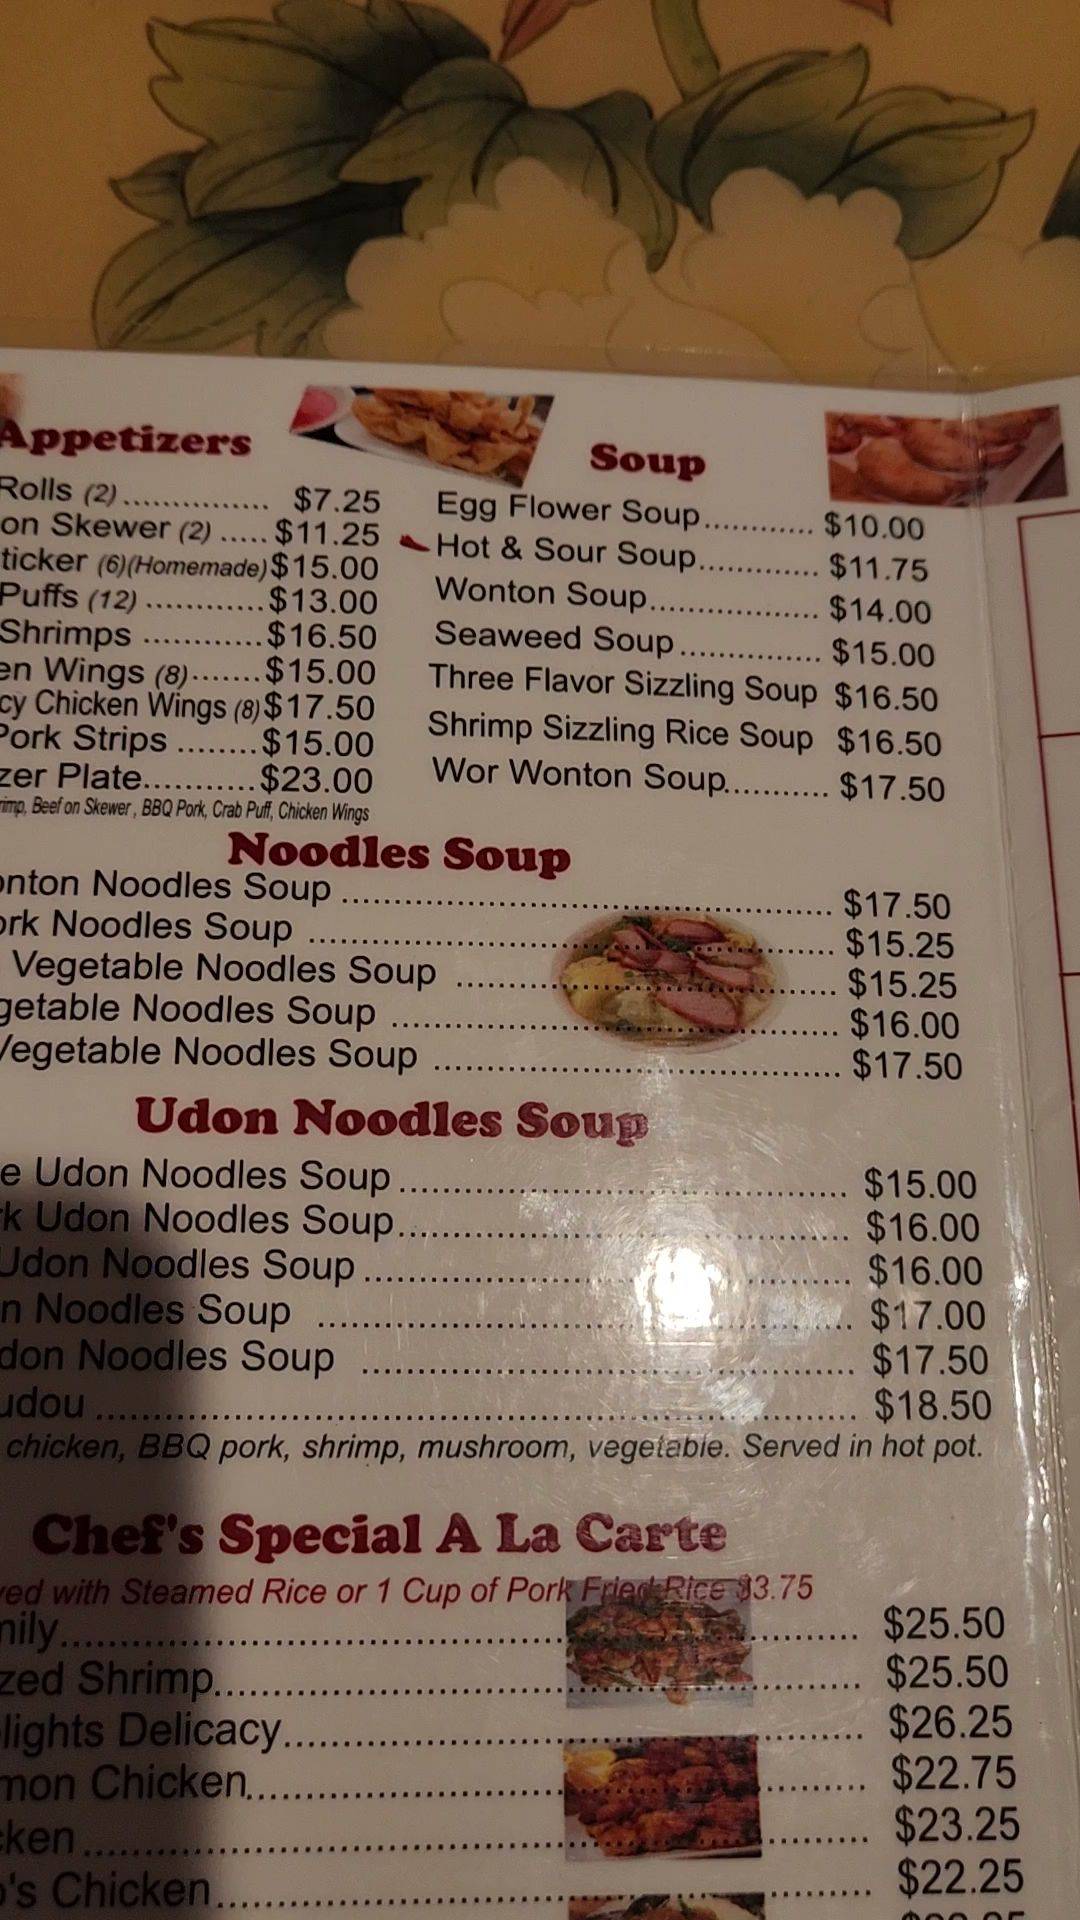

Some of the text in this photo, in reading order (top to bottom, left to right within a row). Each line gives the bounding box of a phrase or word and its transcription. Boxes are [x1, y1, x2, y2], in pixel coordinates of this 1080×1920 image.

[590, 443, 706, 482] Soup
[84, 483, 116, 507] (2)
[294, 485, 380, 514] $7.25
[438, 491, 925, 541] Egg Flower Soup $10.00
[0, 512, 379, 547] on Skewer (2) $11.25
[1, 546, 88, 572] ticker
[270, 551, 378, 581] $15.00
[438, 533, 928, 582] Hot & Sour Soup $11.75
[88, 589, 136, 614] (12)
[269, 585, 377, 615] $13.00
[435, 576, 931, 624] Wonton Soup $14.00
[267, 620, 376, 650] $16.50
[435, 620, 935, 668] Seaweed Soup $15.00
[44, 656, 144, 694] Wings
[155, 664, 187, 690] (8)
[266, 655, 375, 686] $15.00
[428, 663, 938, 712] Three Flavor Sizzling Soup $16.50
[35, 689, 374, 725] Chicken Wings (8) $17.50
[73, 724, 373, 758] Strips $15.00
[428, 710, 942, 757] Shrimp Sizzling Rice Soup $16.50
[58, 762, 142, 790] Plate
[260, 763, 372, 795] $23.00
[432, 756, 945, 802] Wor Wonton Soup $17.50
[31, 796, 369, 826] Beef on Skewer BBQ Pork, Crab Puff, Chicken Wings
[228, 831, 571, 880] Noodles Soup
[93, 869, 950, 920] Noodles Soup $17.50
[53, 909, 954, 959] Noodles Soup $15.25
[12, 949, 957, 1000] Vegetable Noodles Soup $15.25
[133, 993, 274, 1024] Noodles
[287, 995, 375, 1032] Soup
[851, 1007, 959, 1040] $16.00
[175, 1036, 316, 1067] Noodles
[329, 1039, 417, 1076] Soup
[853, 1048, 962, 1081] $17.50
[135, 1096, 649, 1148] Udon Noodles Soup
[36, 1157, 976, 1202] Udon Noodles Soup $15.00
[36, 1200, 979, 1245] Udon Noodles Soup $16.00
[102, 1247, 249, 1282] Noodles
[263, 1249, 354, 1288] Soup
[869, 1253, 982, 1289] $16.00
[35, 1292, 985, 1334] Noodles Soup $17.00
[78, 1338, 227, 1373] Noodles
[241, 1340, 334, 1380] Soup
[873, 1342, 988, 1379] $17.50
[875, 1387, 991, 1424] $18.50
[7, 1433, 982, 1467] chicken, BBQ pork, shrimp, mushroom, vegetable. Served in hot pot.
[33, 1512, 727, 1564] Chef's Special A La Carte
[53, 1572, 814, 1609] with Steamed Rice or 1 Cup of Pork Fried Rice $3.75
[884, 1604, 1004, 1644] $25.50
[78, 1659, 213, 1704] Shrimp
[887, 1652, 1008, 1693] $25.50
[118, 1703, 1012, 1754] Delicacy $26.25
[91, 1763, 248, 1800] Chicken
[892, 1753, 1016, 1795] $22.75
[895, 1804, 1020, 1847] $23.25
[53, 1857, 1024, 1908] Chicken $22.25
